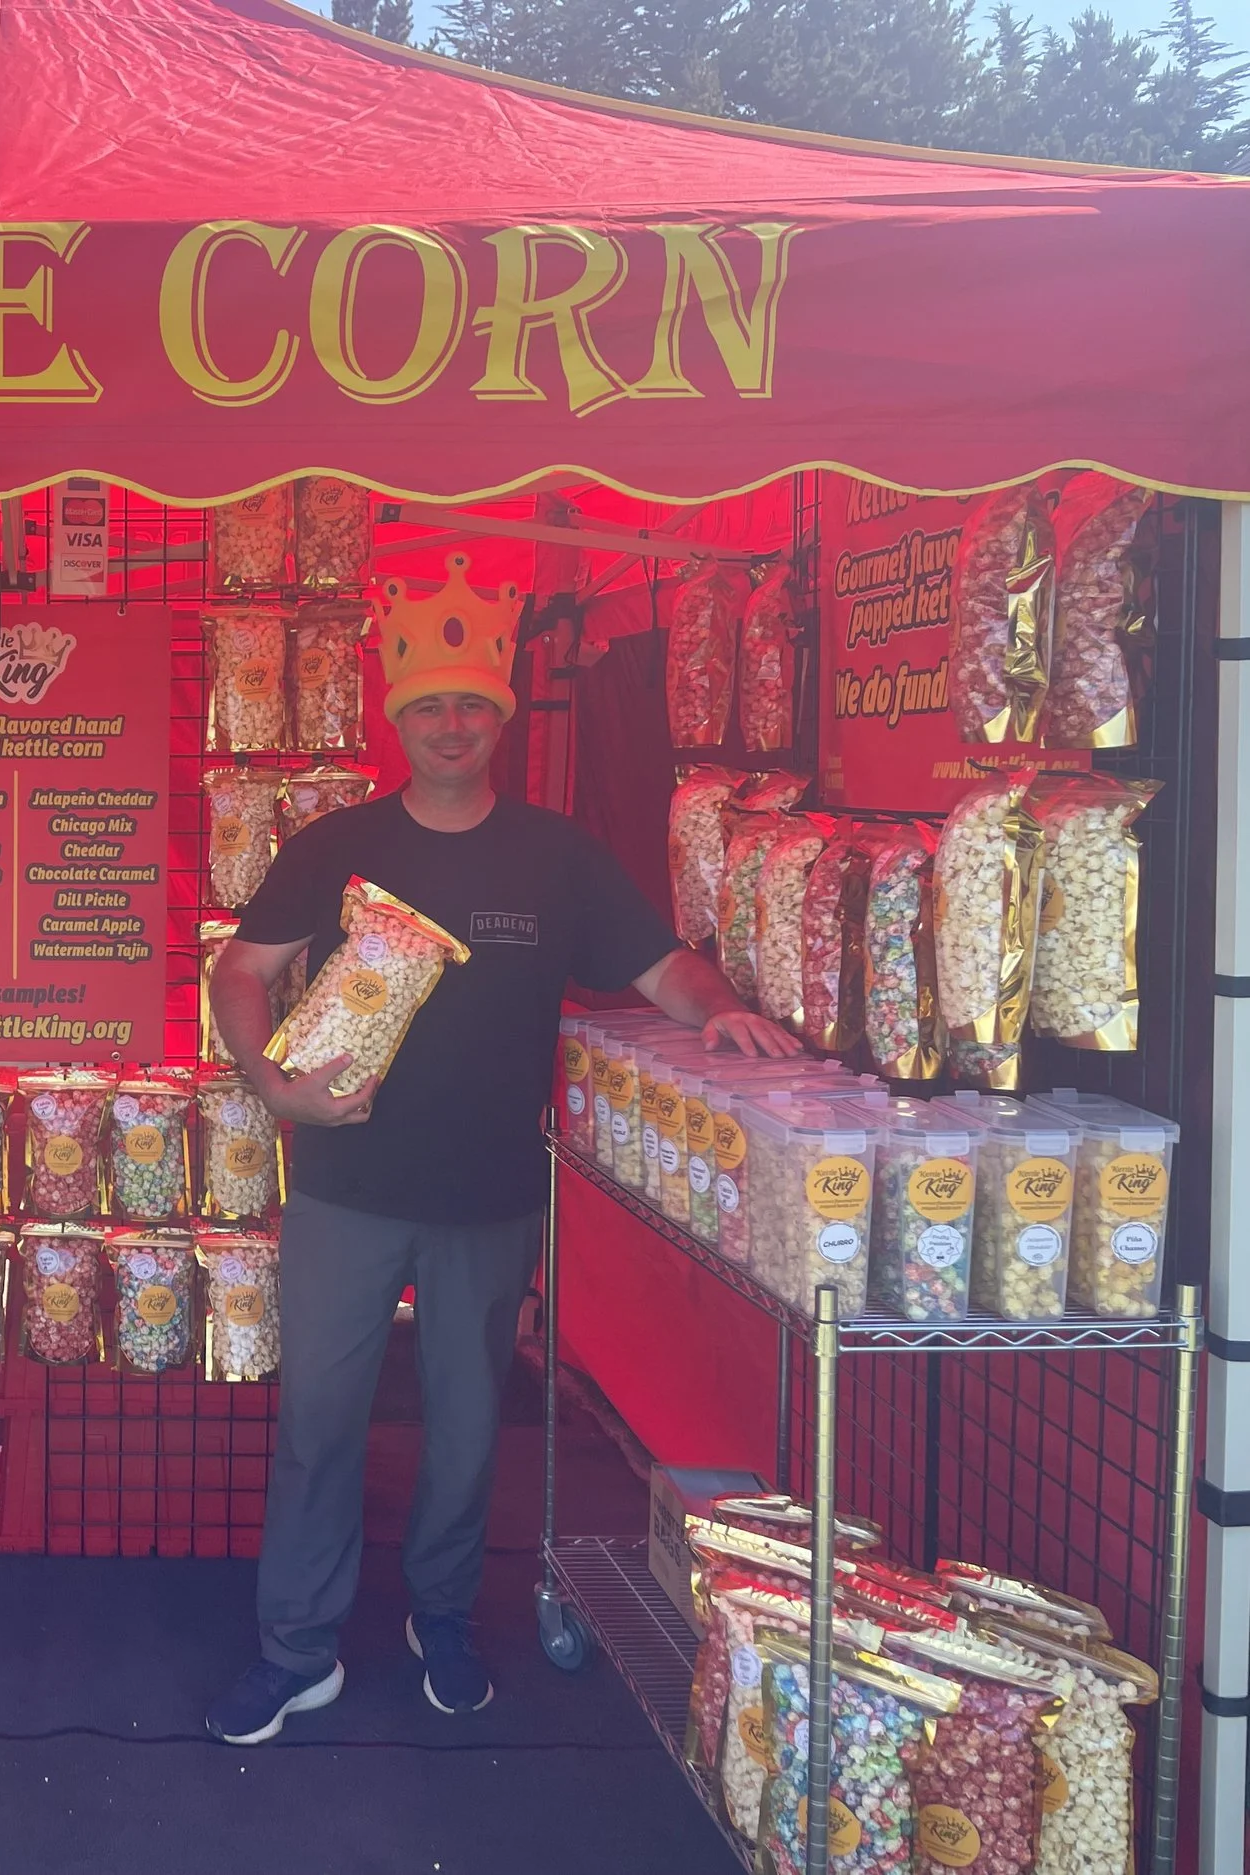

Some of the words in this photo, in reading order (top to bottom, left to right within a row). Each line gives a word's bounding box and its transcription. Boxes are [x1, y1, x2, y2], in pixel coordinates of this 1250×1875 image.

[158, 221, 805, 417] CORN
[67, 533, 102, 547] VISA
[64, 560, 101, 568] DISCOVER
[836, 541, 907, 593] Gourmet
[850, 587, 915, 644] popped
[835, 671, 861, 716] We
[862, 668, 891, 714] do
[75, 716, 123, 735] hand
[2, 739, 60, 757] kettle
[62, 742, 103, 757] corn
[32, 791, 95, 808] Jalapeño
[97, 792, 153, 806] Cheddar
[52, 818, 105, 835] Chicago
[108, 819, 133, 832] Mix
[64, 843, 120, 857] Cheddar
[29, 867, 96, 881] Chocolate
[99, 867, 155, 881] Caramel
[58, 893, 82, 907] Dill
[85, 893, 126, 907] Pickle
[43, 919, 98, 932] Caramel
[101, 919, 140, 935] Apple
[477, 917, 534, 933] DEADEND
[34, 943, 113, 957] Watermelon
[813, 1176, 855, 1196] King
[916, 1178, 958, 1198] King
[1015, 1177, 1057, 1198] King
[1108, 1173, 1151, 1194] King
[823, 1238, 854, 1248] CHURRO
